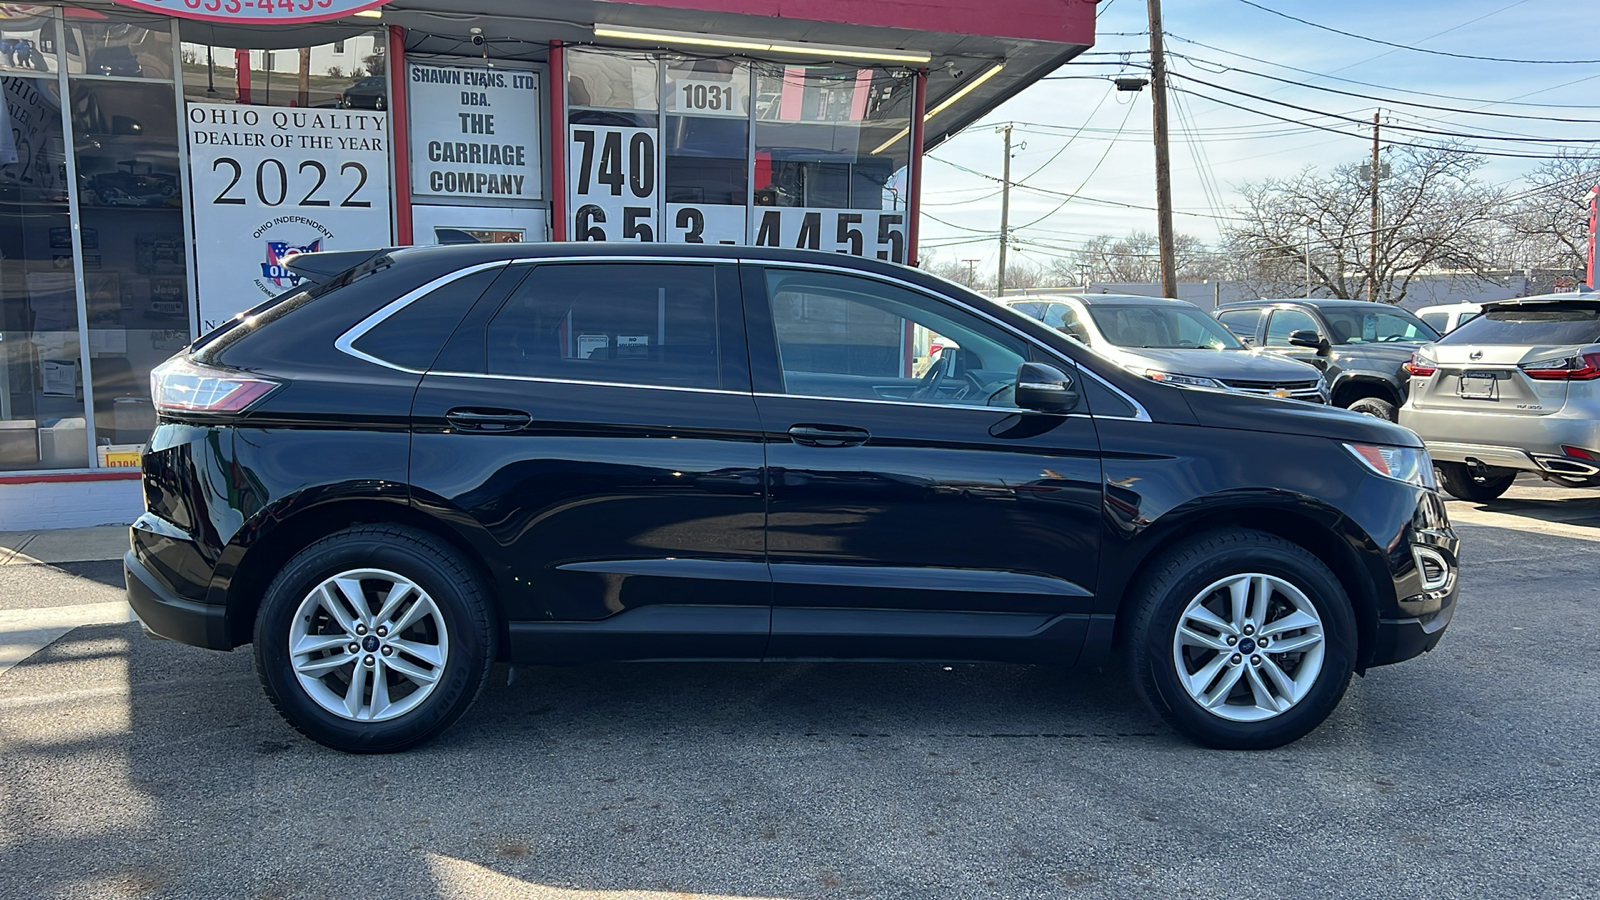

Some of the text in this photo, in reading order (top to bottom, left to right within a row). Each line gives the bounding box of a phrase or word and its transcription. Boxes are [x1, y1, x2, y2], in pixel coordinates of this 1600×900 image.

[412, 67, 537, 90] SHAWN EVANS. LTD.
[461, 91, 491, 107] DBA.
[682, 83, 733, 111] 1031
[190, 107, 385, 131] OHIO QUALITY
[458, 112, 495, 135] THE
[194, 131, 383, 151] DEALER OF THE YEAR
[428, 140, 525, 166] CARRIAGE
[573, 130, 654, 198] 740
[212, 157, 371, 208] 2022
[430, 170, 525, 195] COMPANY
[253, 215, 335, 240] OHIO INDEPENDENT
